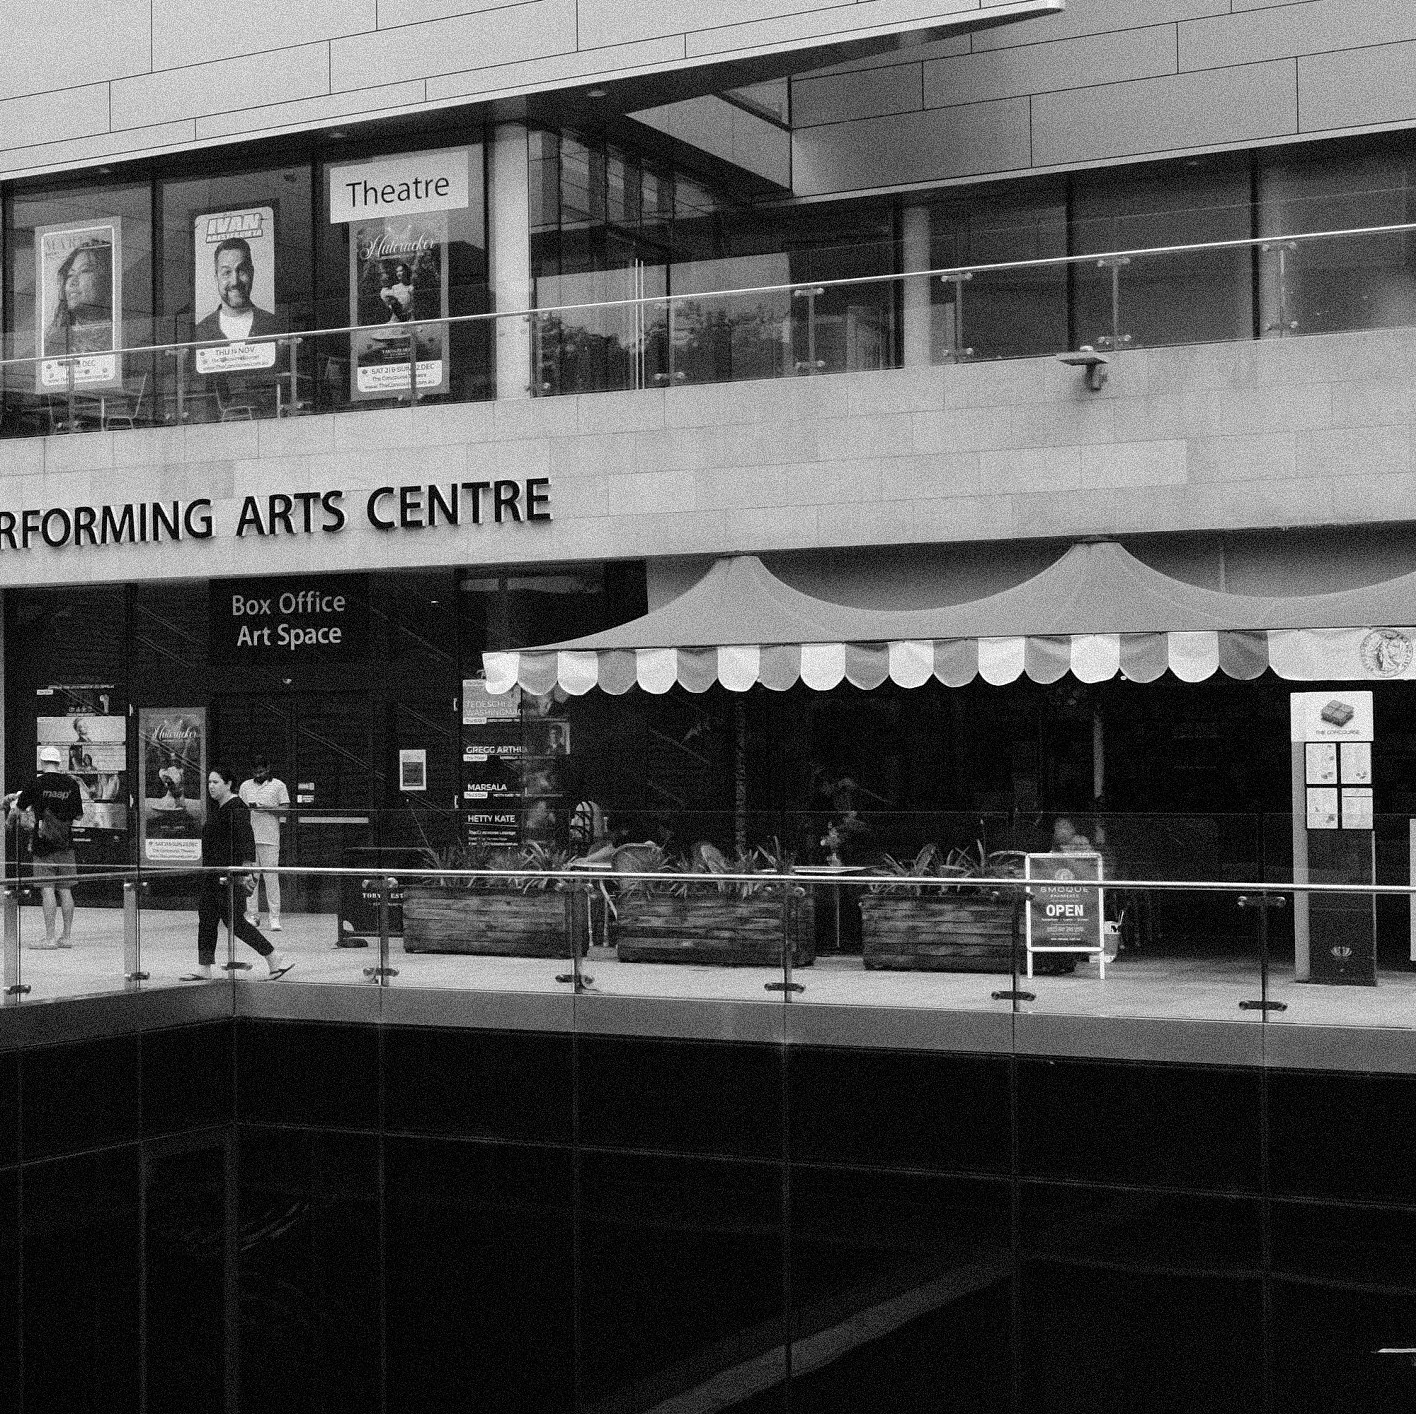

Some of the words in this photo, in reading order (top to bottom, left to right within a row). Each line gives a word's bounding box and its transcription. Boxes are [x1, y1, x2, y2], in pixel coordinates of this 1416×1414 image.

[345, 176, 450, 208] Theatre
[207, 213, 263, 235] IVAN
[238, 346, 256, 355] NOV
[235, 489, 347, 538] ARTS
[366, 476, 554, 532] CENTRE
[232, 594, 272, 616] Box
[278, 590, 346, 614] Office
[236, 625, 272, 647] Art
[276, 623, 343, 651] Space
[466, 745, 495, 754] GREGG
[467, 783, 508, 791] MARSALA
[467, 814, 493, 823] HETTY
[494, 814, 516, 823] KATE
[1045, 904, 1084, 917] OPEN
